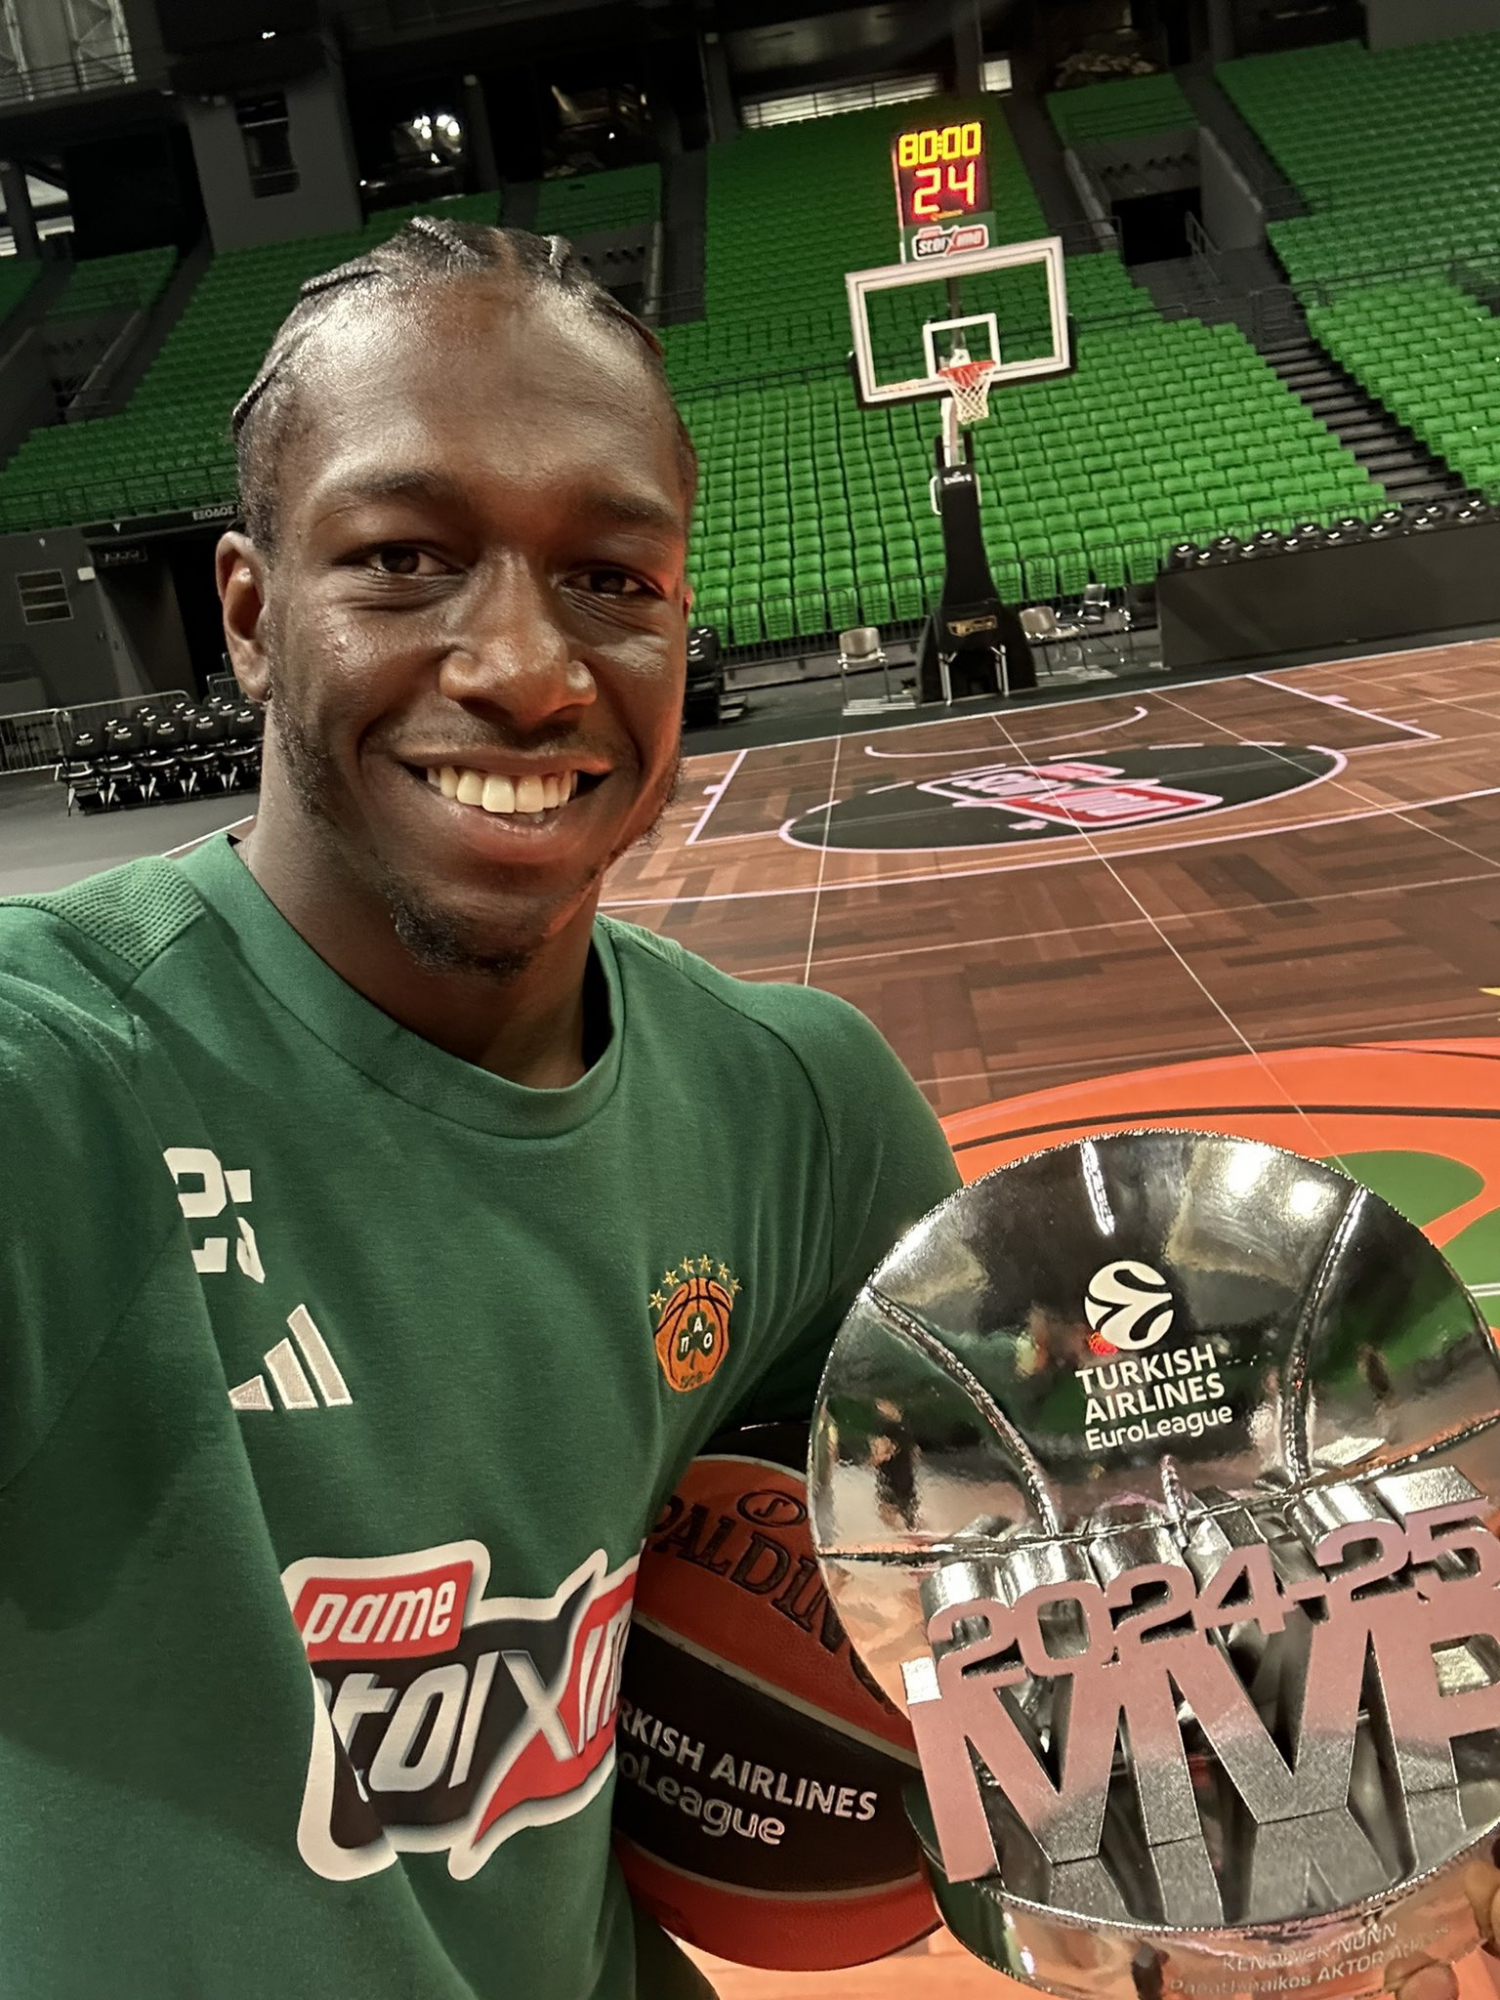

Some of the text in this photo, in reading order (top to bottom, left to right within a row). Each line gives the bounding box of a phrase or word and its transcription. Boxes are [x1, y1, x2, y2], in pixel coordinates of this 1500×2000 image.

[898, 121, 982, 168] 80:00
[913, 161, 976, 214] 24
[1074, 1343, 1217, 1395] TURKISH
[1084, 1372, 1226, 1426] AIRLINES
[1084, 1405, 1233, 1451] EuroLeague
[301, 1580, 457, 1643] pame
[927, 1497, 1500, 1680] 2024-25
[619, 1702, 878, 1821] RKISH AIRLINES
[905, 1590, 1500, 1883] MVP
[619, 1751, 786, 1845] oLeague
[1337, 1921, 1398, 1955] NUNN
[1317, 1950, 1384, 1984] AKTOR
